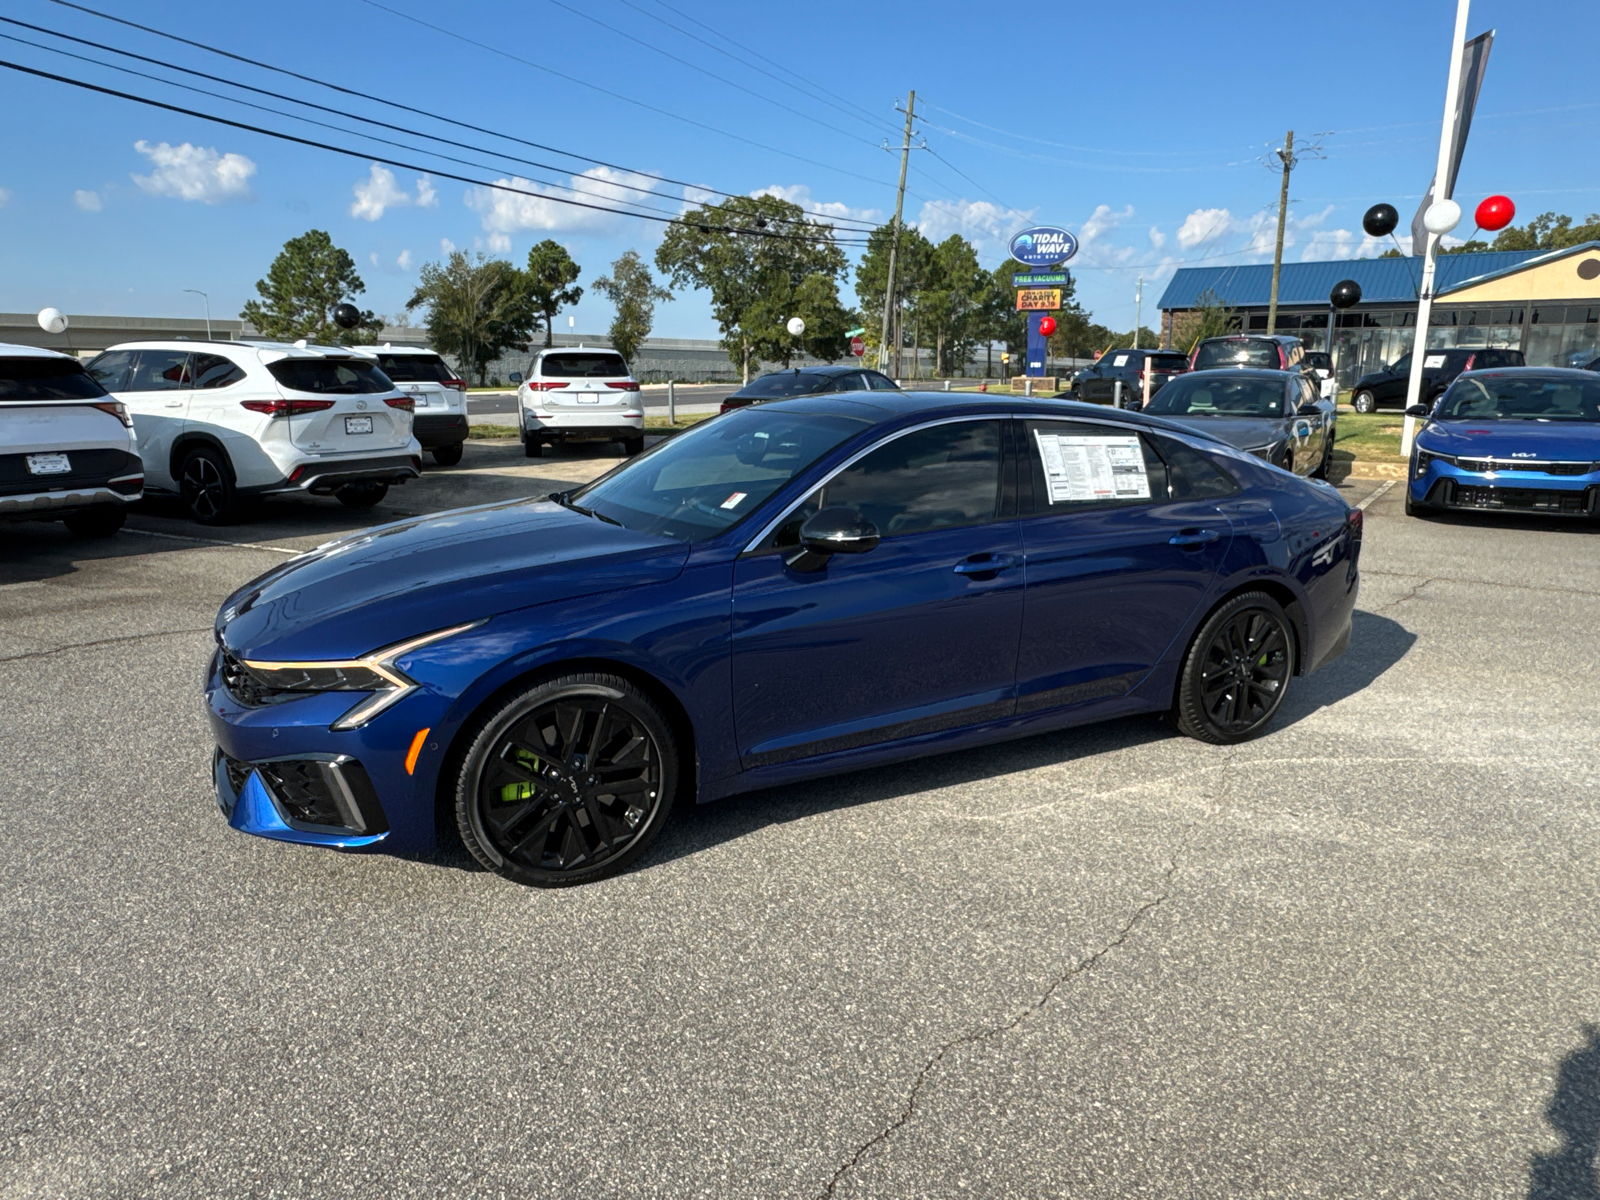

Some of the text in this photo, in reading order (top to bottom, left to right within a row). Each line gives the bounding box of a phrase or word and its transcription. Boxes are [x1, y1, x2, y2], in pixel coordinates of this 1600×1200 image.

[1033, 234, 1064, 244] TIDAL
[1037, 244, 1071, 254] WAVE
[1015, 274, 1066, 283] FREE VACUUMS
